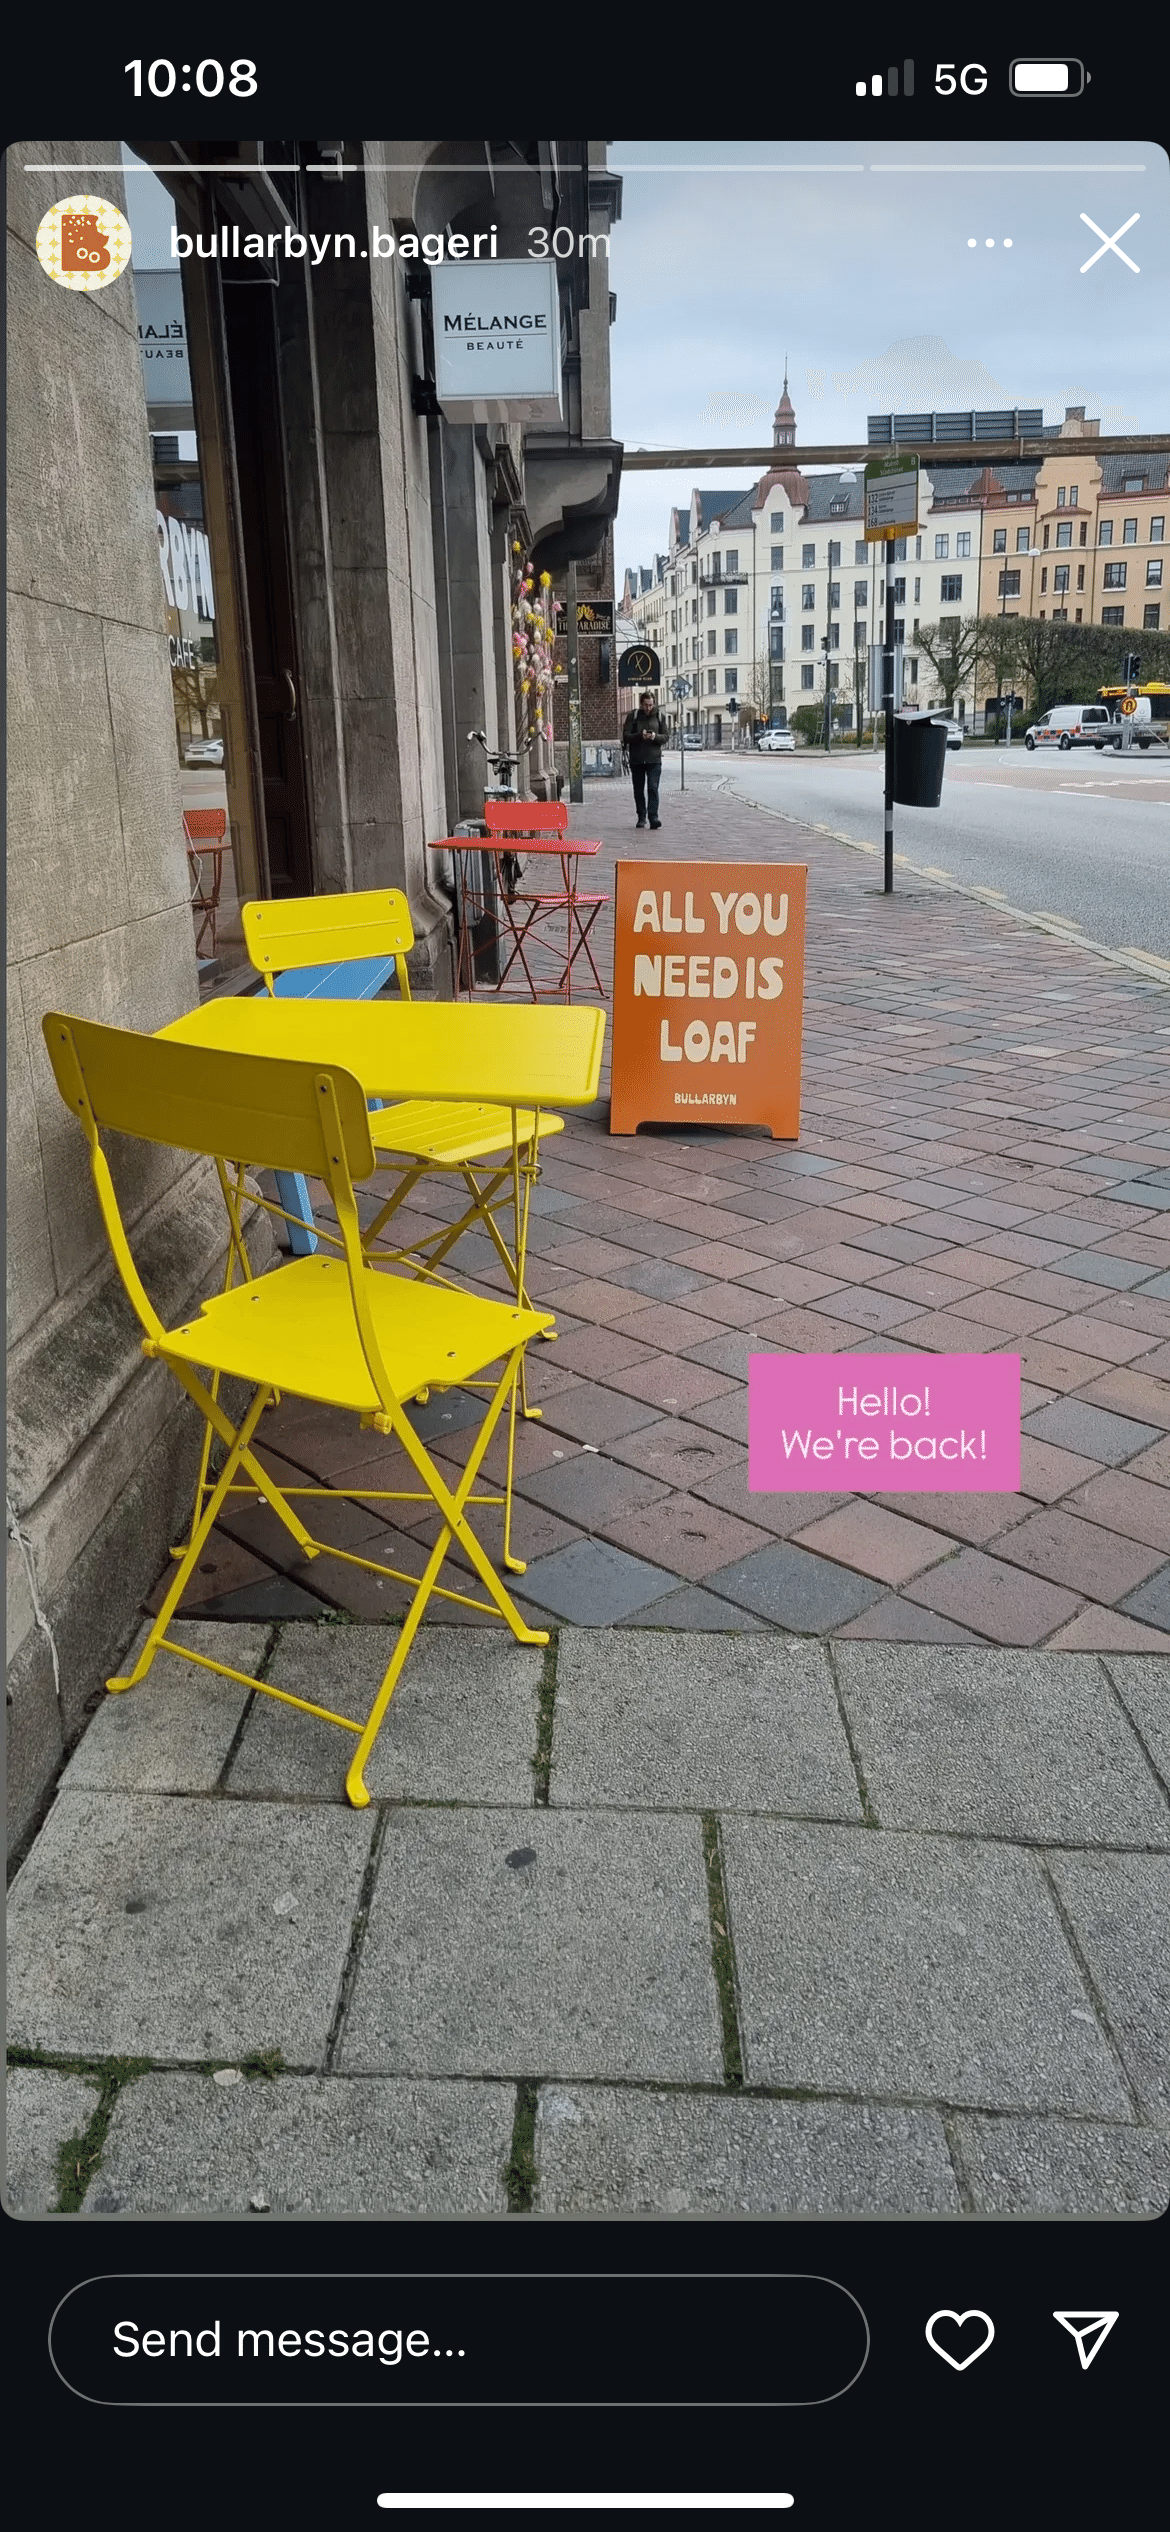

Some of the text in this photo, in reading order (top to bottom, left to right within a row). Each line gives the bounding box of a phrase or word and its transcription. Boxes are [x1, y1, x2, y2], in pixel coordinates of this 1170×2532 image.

[444, 312, 547, 331] MÉLANGE
[466, 338, 524, 351] BEAUTÉ
[868, 493, 879, 504] 132
[868, 505, 878, 516] 134
[868, 517, 878, 528] 168
[168, 630, 196, 670] CAFÉ
[633, 890, 790, 937] ALL YOU
[633, 954, 785, 1000] NEED IS
[660, 1019, 757, 1063] LOAF
[673, 1092, 737, 1106] BULLARBYN
